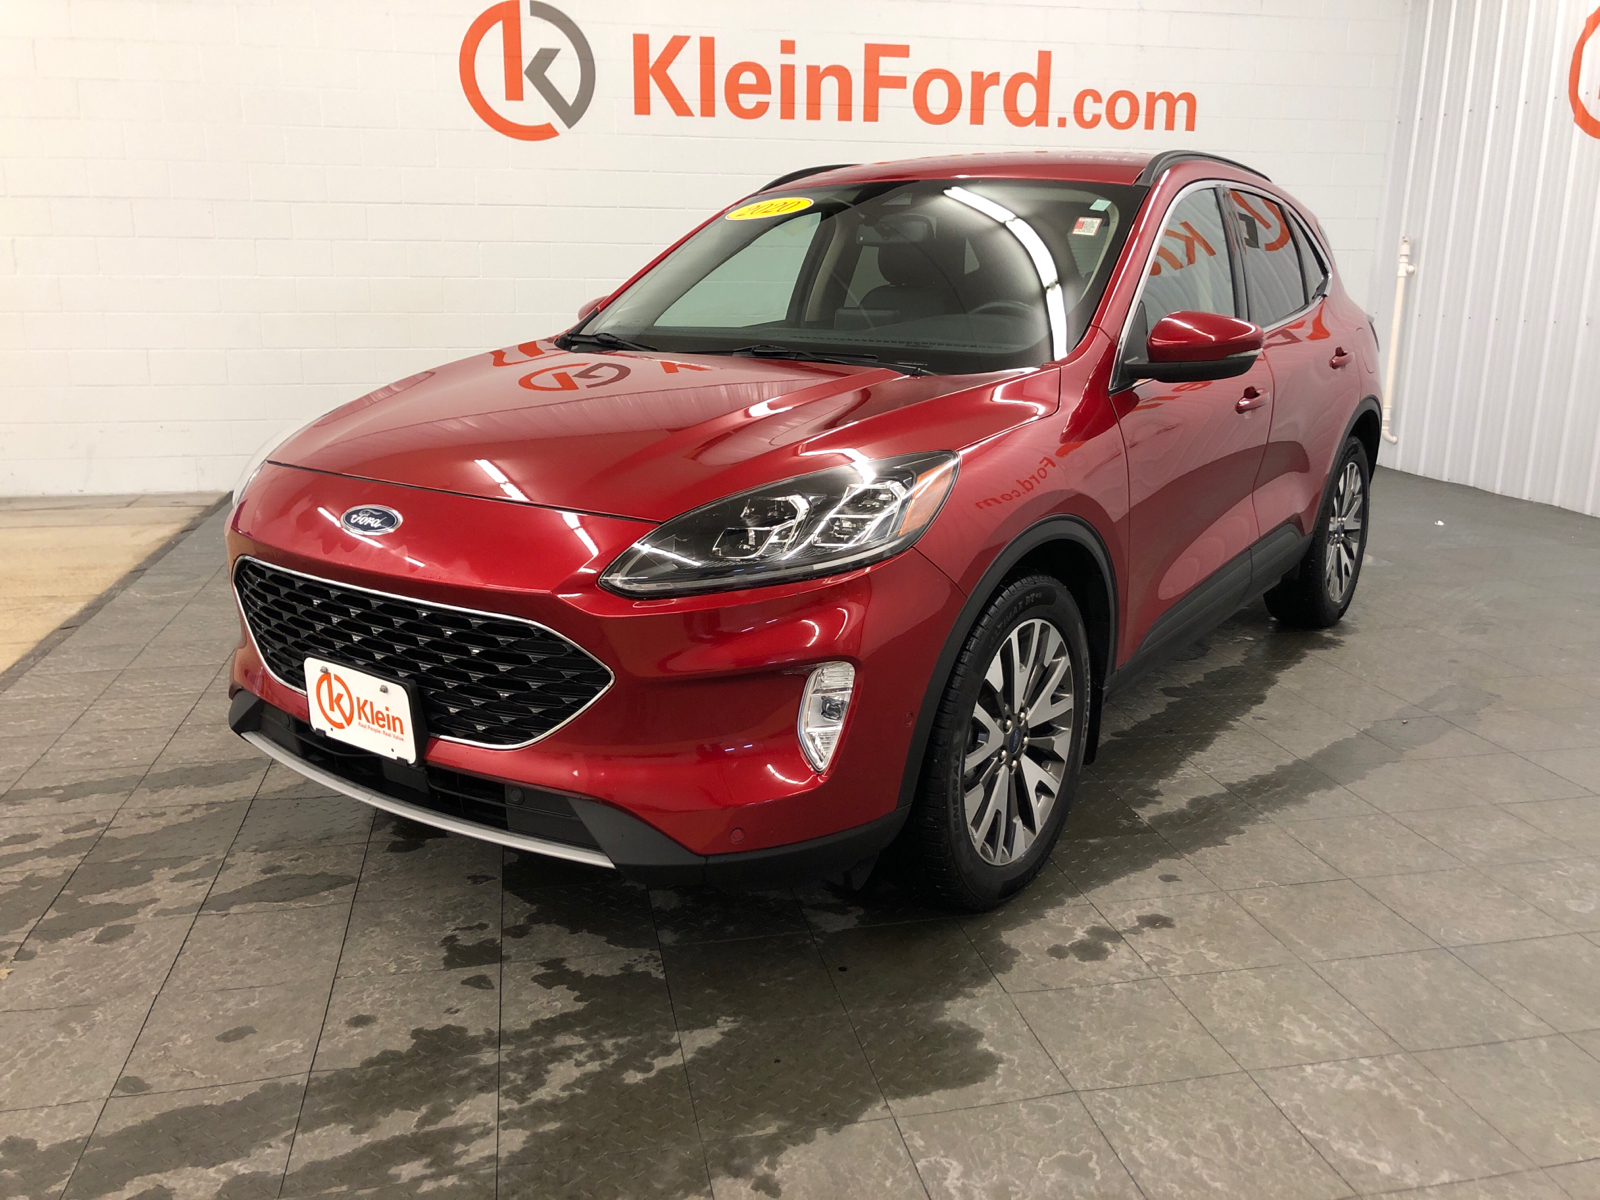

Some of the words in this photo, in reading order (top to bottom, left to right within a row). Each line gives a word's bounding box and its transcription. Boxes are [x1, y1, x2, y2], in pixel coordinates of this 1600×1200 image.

[632, 33, 1196, 132] KleinFord.com
[350, 509, 388, 528] Ford
[356, 696, 404, 735] Klein
